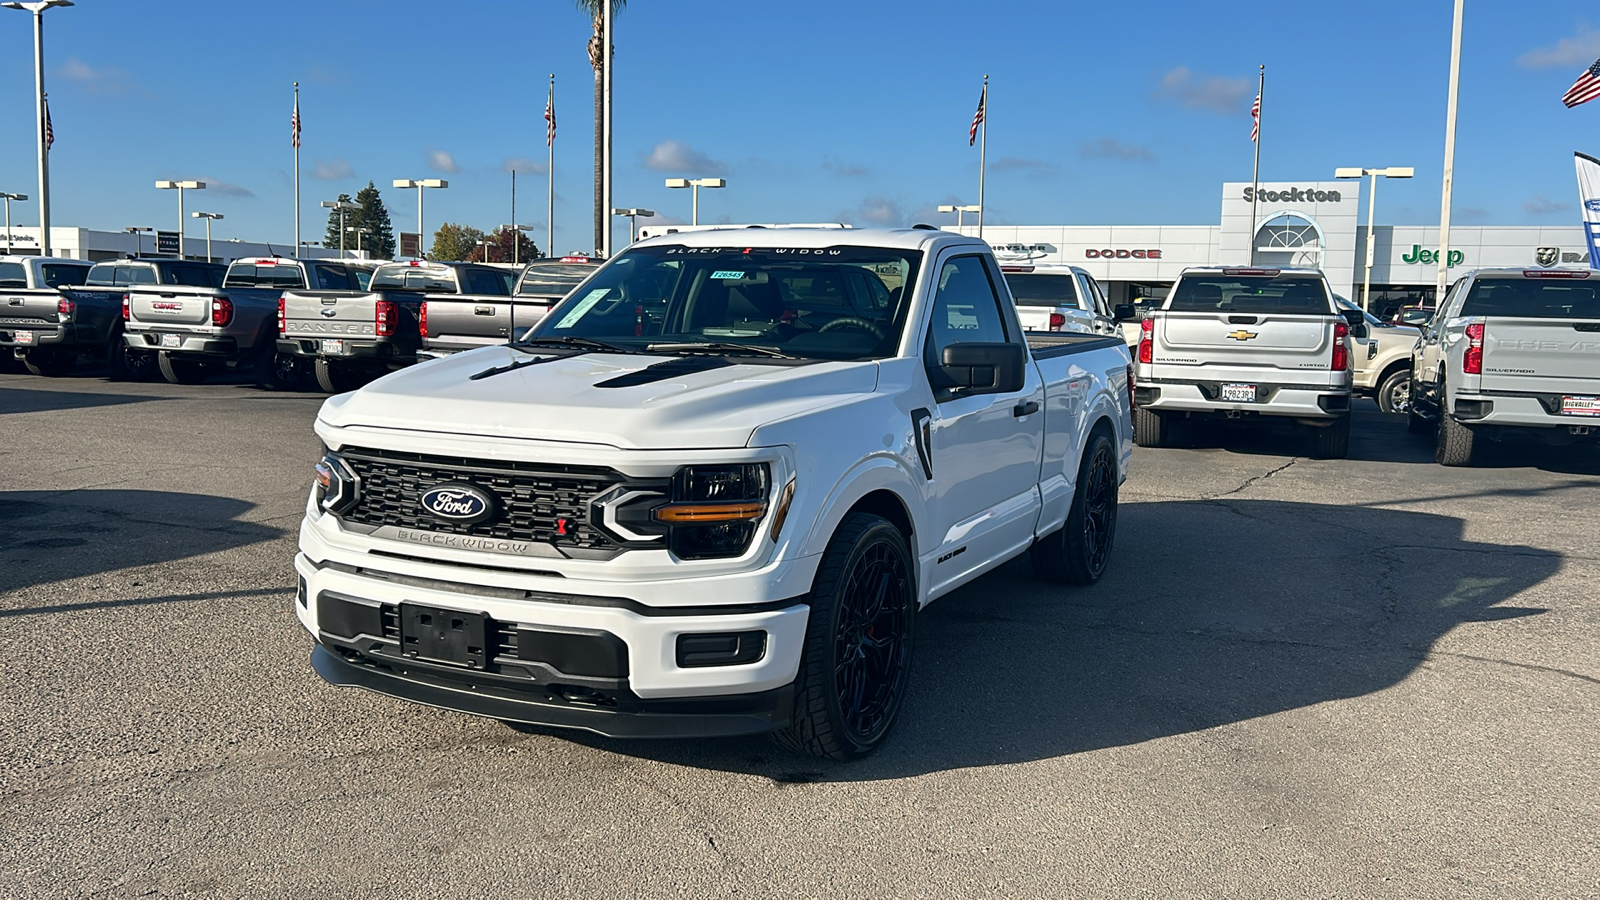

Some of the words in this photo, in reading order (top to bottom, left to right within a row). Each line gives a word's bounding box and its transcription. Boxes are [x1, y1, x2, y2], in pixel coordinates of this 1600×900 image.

[1243, 186, 1341, 203] Stockton
[775, 248, 841, 256] WIDOW
[1085, 249, 1162, 259] DODGE
[1561, 252, 1590, 263] RA
[153, 302, 182, 311] GMC
[288, 322, 374, 334] RANGER
[433, 491, 473, 515] Ford
[397, 530, 456, 546] BLACK
[462, 537, 528, 553] WIDOW
